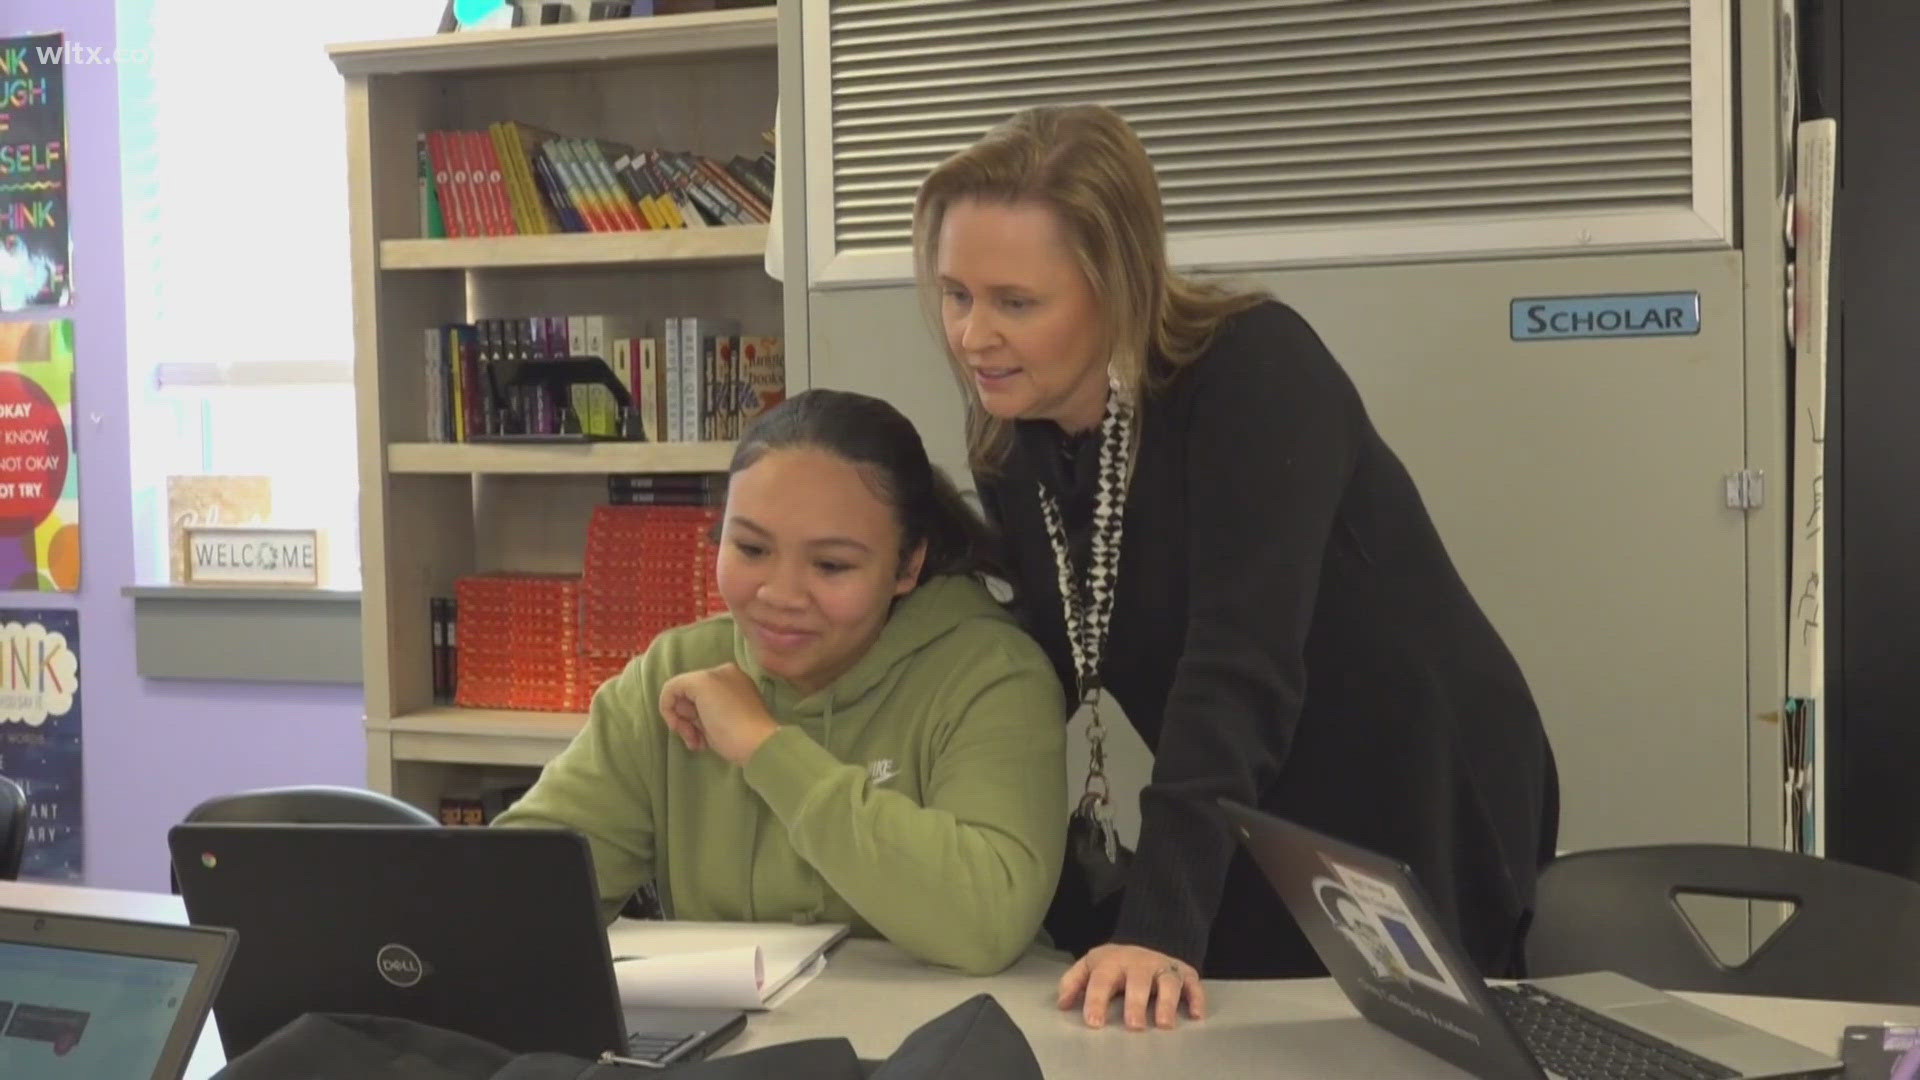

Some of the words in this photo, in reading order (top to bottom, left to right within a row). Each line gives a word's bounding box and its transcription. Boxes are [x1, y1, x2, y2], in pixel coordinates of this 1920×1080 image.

[1527, 305, 1683, 333] SCHOLAR
[26, 455, 59, 471] OKAY
[196, 543, 314, 570] WELCOME
[383, 959, 418, 972] DELL
